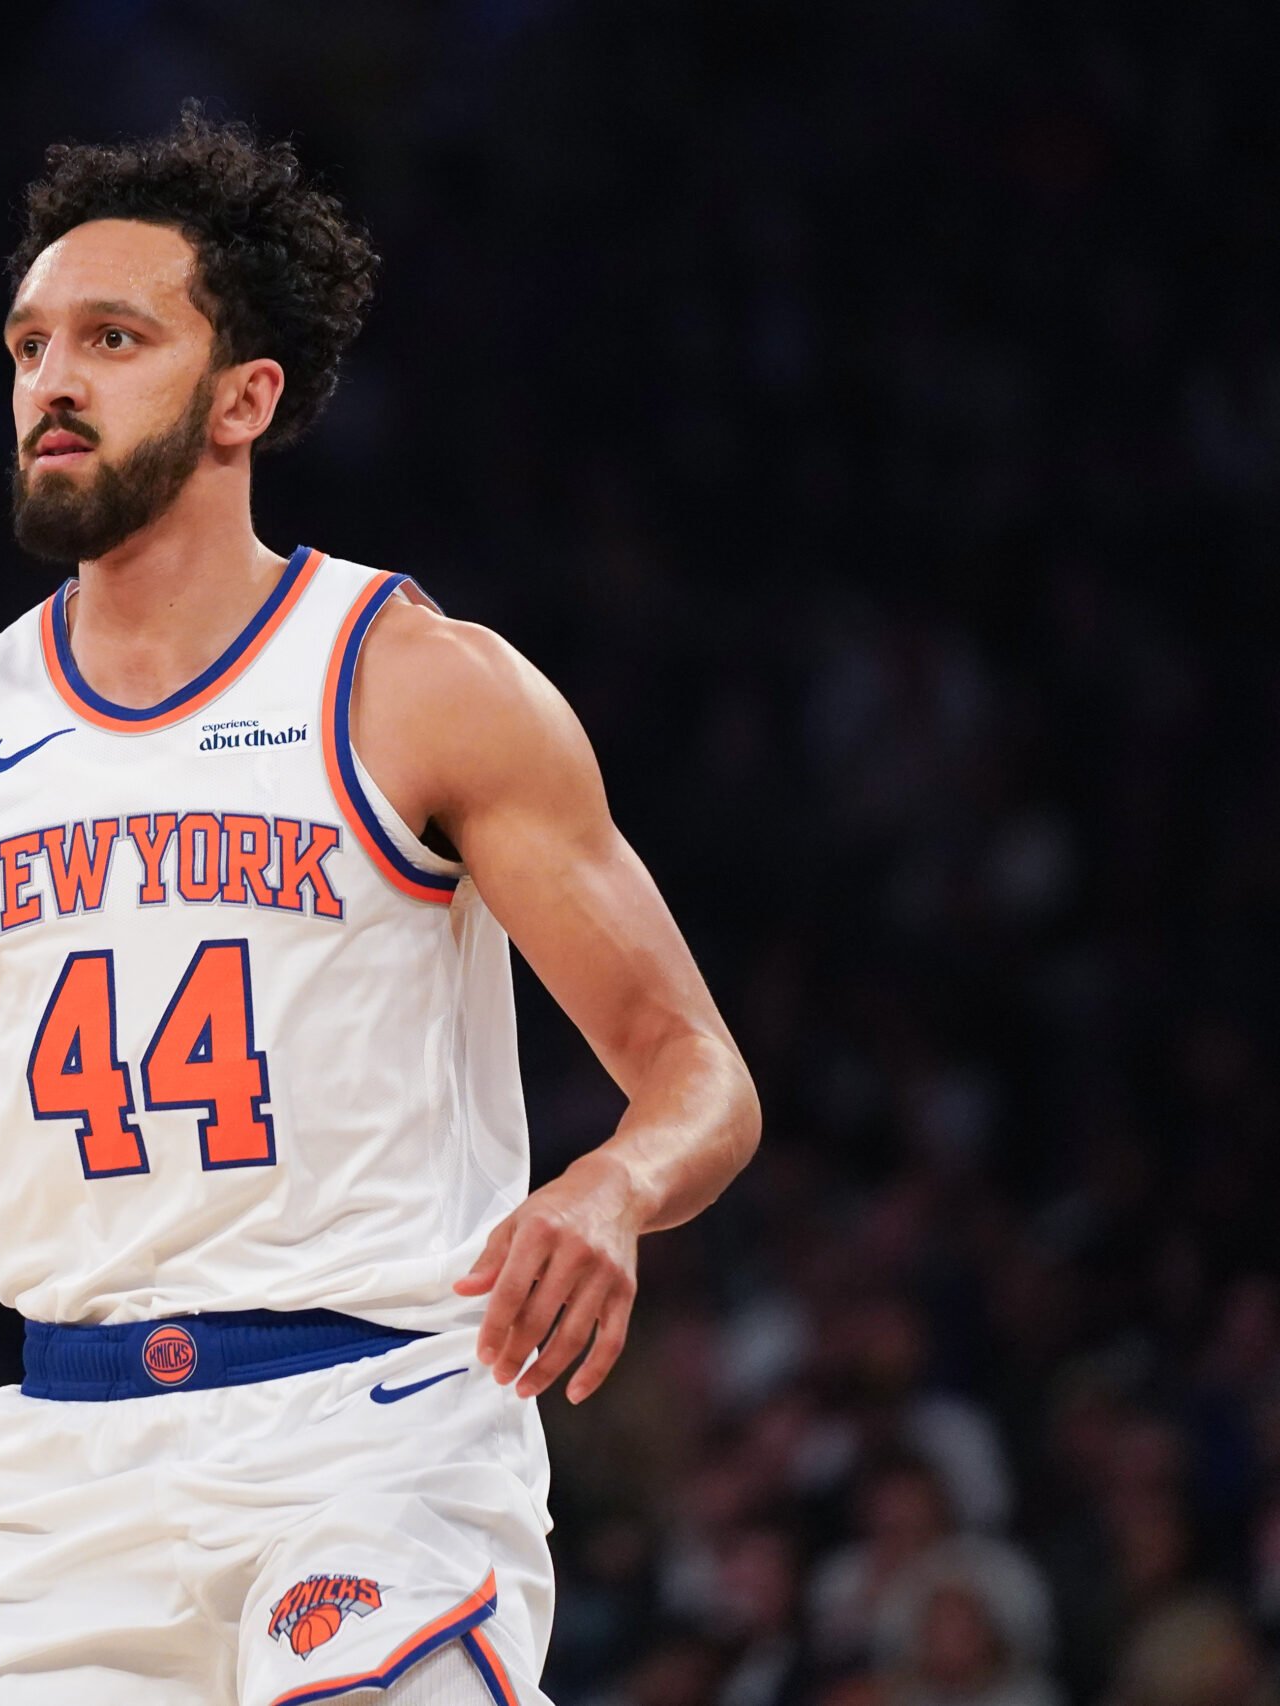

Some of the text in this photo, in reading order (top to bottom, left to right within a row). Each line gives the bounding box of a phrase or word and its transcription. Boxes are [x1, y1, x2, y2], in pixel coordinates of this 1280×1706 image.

[200, 733, 240, 751] abu
[202, 720, 259, 732] experience
[126, 810, 344, 922] YORK
[26, 937, 277, 1180] 44
[149, 1341, 190, 1369] KNICKS
[267, 1577, 382, 1636] KNICKS
